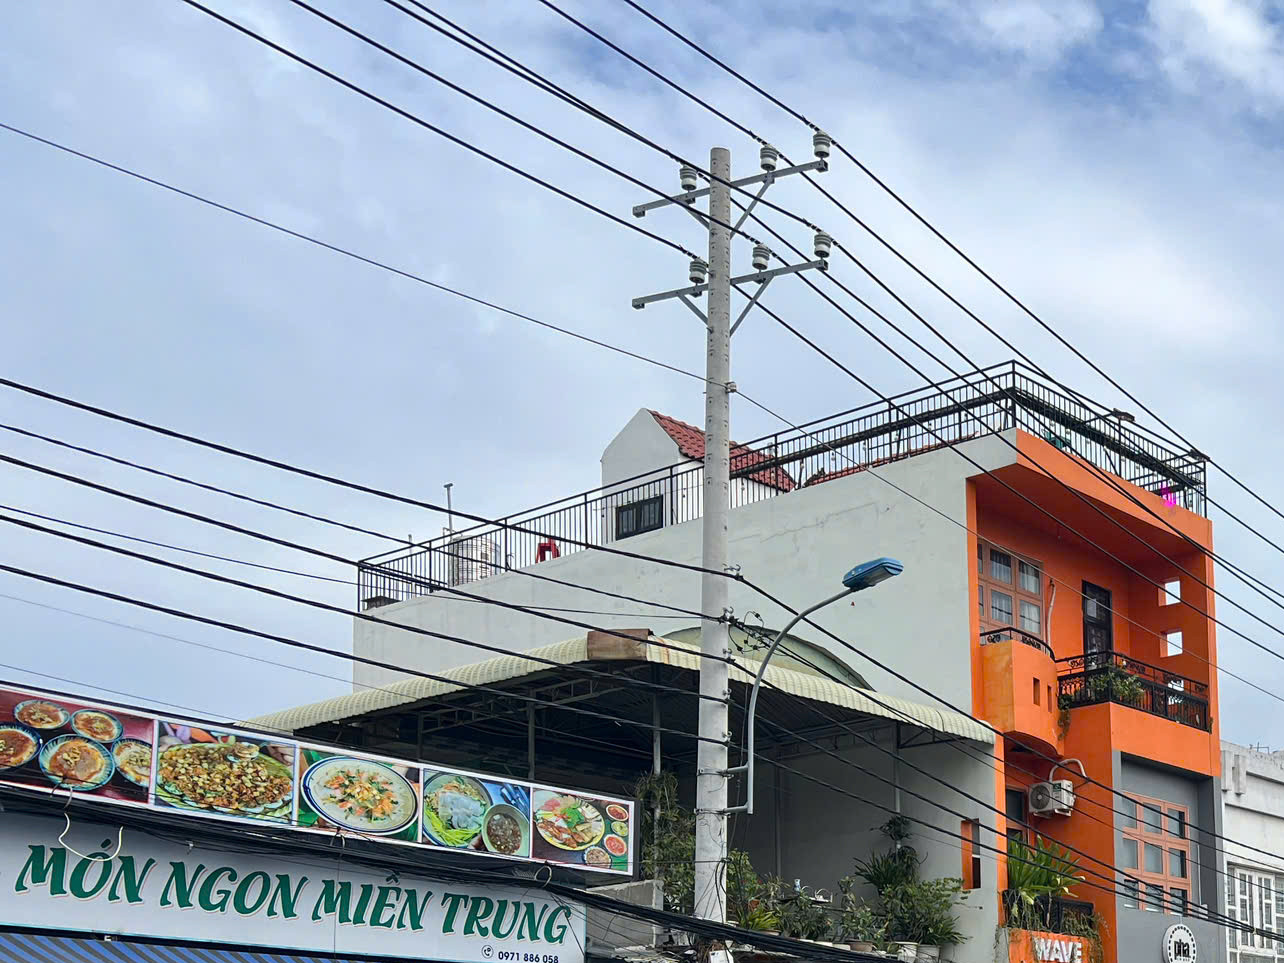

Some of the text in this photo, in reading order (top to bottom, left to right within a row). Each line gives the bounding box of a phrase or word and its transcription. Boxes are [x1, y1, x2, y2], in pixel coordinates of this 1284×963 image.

[15, 838, 572, 944] MÓN NGON MIỀN TRUNG
[498, 951, 520, 961] 0971
[523, 953, 540, 963] 886
[1033, 937, 1082, 963] WAVE
